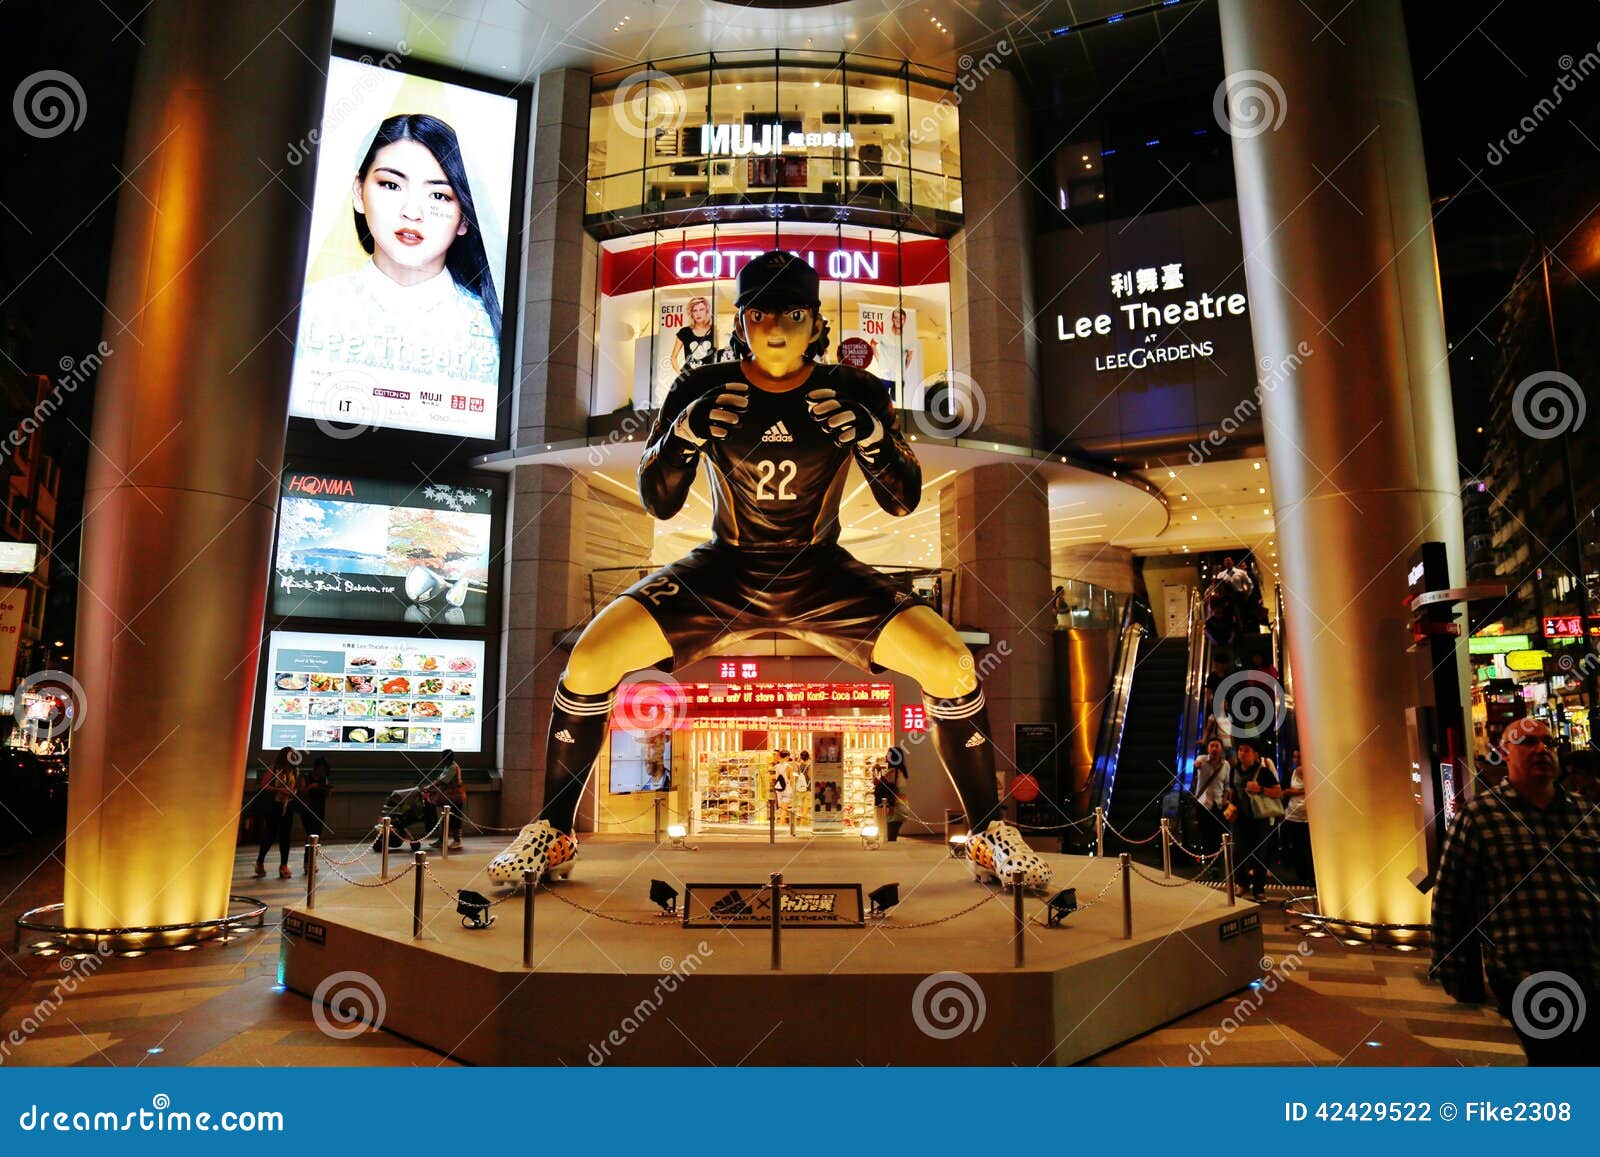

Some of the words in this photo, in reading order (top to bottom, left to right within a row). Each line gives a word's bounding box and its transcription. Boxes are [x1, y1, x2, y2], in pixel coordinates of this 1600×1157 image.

[701, 124, 782, 154] MUJI
[828, 250, 880, 279] ON
[661, 305, 675, 314] GET
[676, 304, 683, 313] IT
[862, 311, 876, 320] GET
[877, 312, 884, 321] IT
[1057, 313, 1112, 341] Lee
[1120, 292, 1246, 330] Theatre
[1145, 334, 1157, 343] AT
[374, 390, 400, 398] COTTON
[420, 391, 442, 402] MUJI
[339, 401, 352, 412] I.T
[289, 475, 354, 496] HONMA
[756, 460, 797, 500] 22
[640, 576, 680, 606] 22
[697, 695, 708, 703] one
[744, 692, 752, 702] UT
[756, 692, 774, 702] store
[777, 692, 784, 701] in
[787, 691, 804, 702] Hong
[832, 690, 850, 701] Coca
[853, 690, 868, 700] Cola
